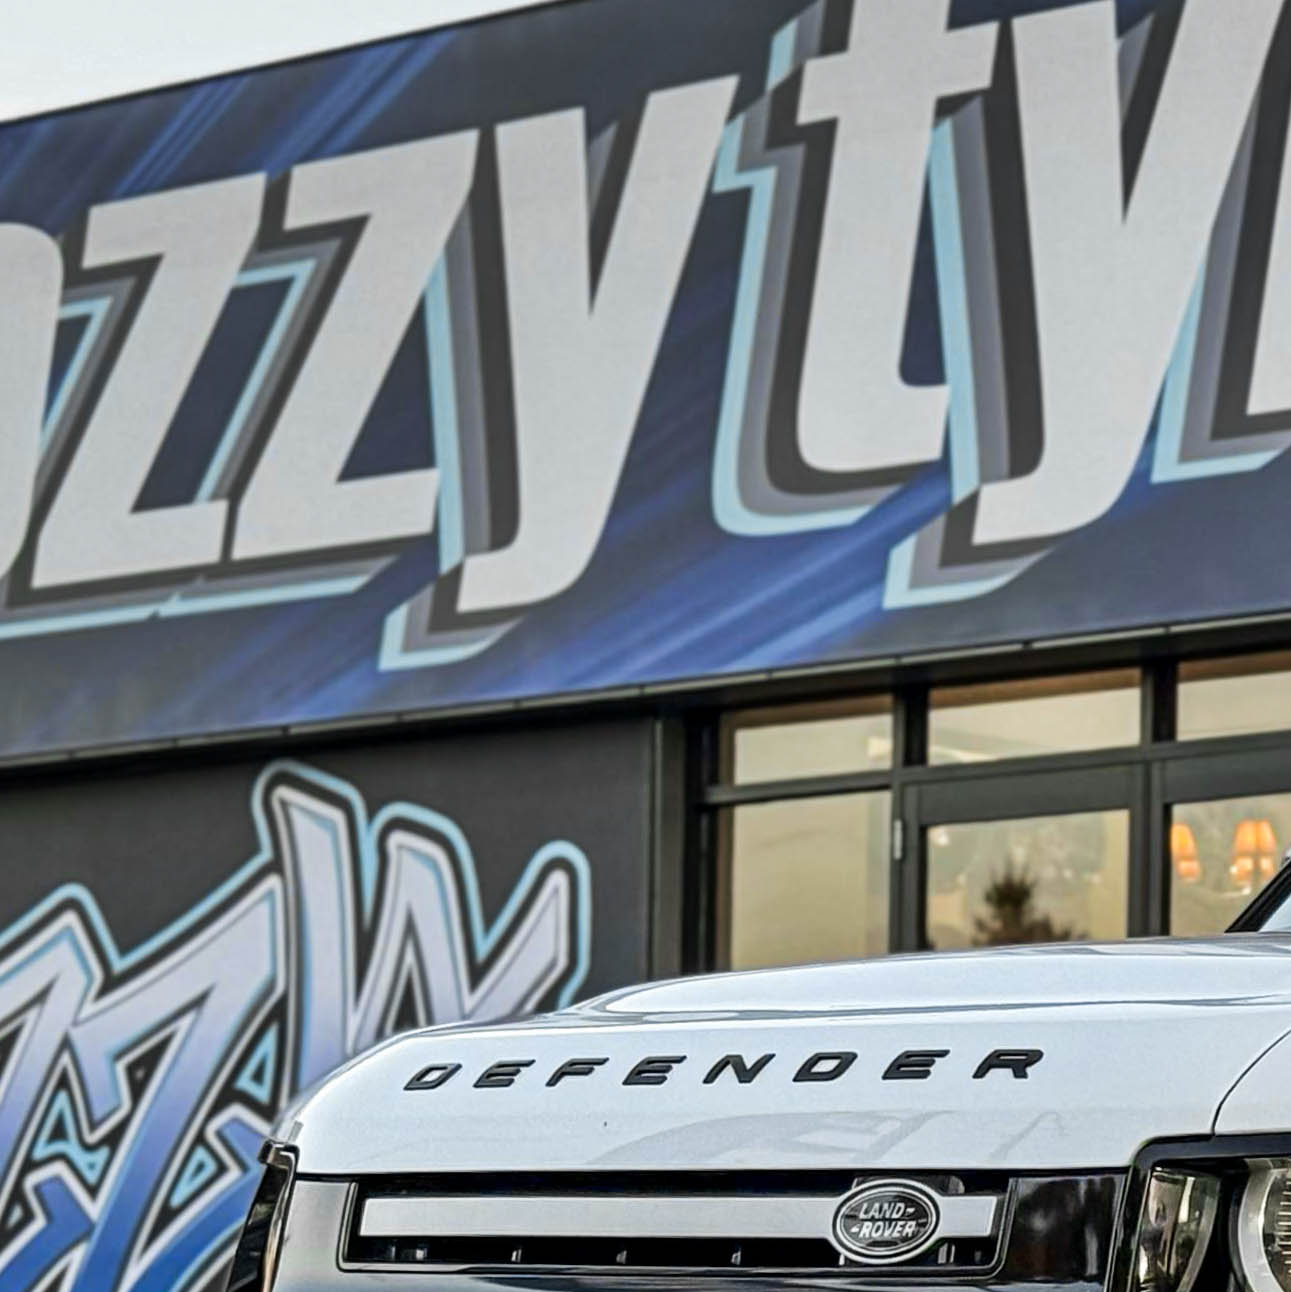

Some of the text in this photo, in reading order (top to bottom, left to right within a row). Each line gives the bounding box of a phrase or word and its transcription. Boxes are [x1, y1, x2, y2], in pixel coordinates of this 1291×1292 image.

[403, 1048, 1044, 1091] DEFENDER
[859, 1202, 905, 1219] LAND
[859, 1220, 917, 1239] ROVER
